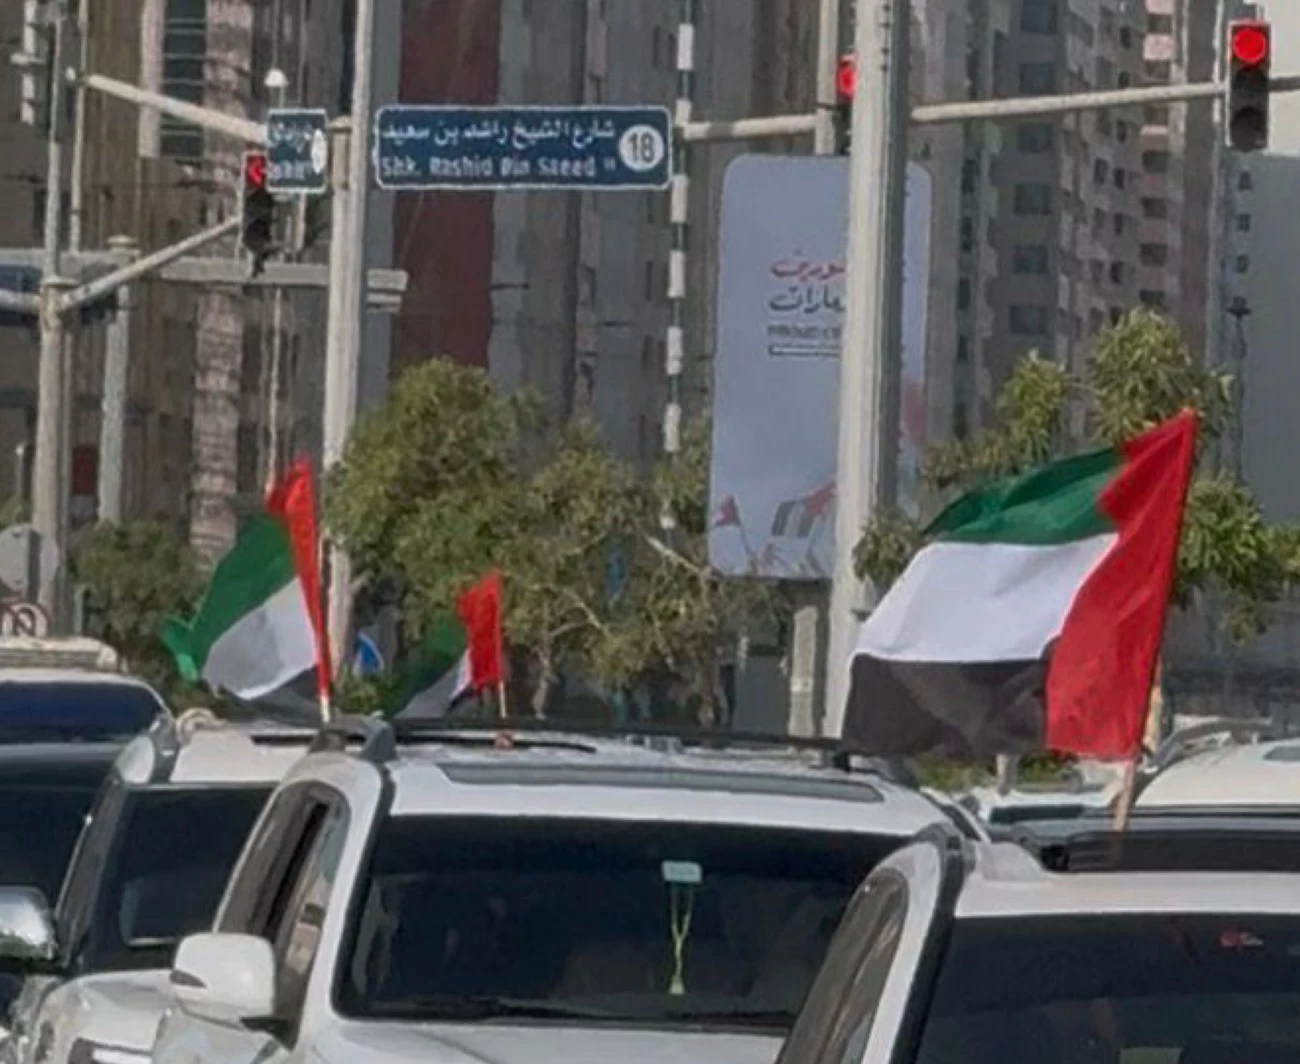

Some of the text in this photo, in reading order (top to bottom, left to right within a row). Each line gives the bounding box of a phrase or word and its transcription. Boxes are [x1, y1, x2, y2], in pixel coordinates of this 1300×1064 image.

[511, 118, 570, 149] الشيخ
[571, 119, 615, 149] شارع
[629, 132, 656, 163] 18
[429, 156, 493, 177] Rashid
